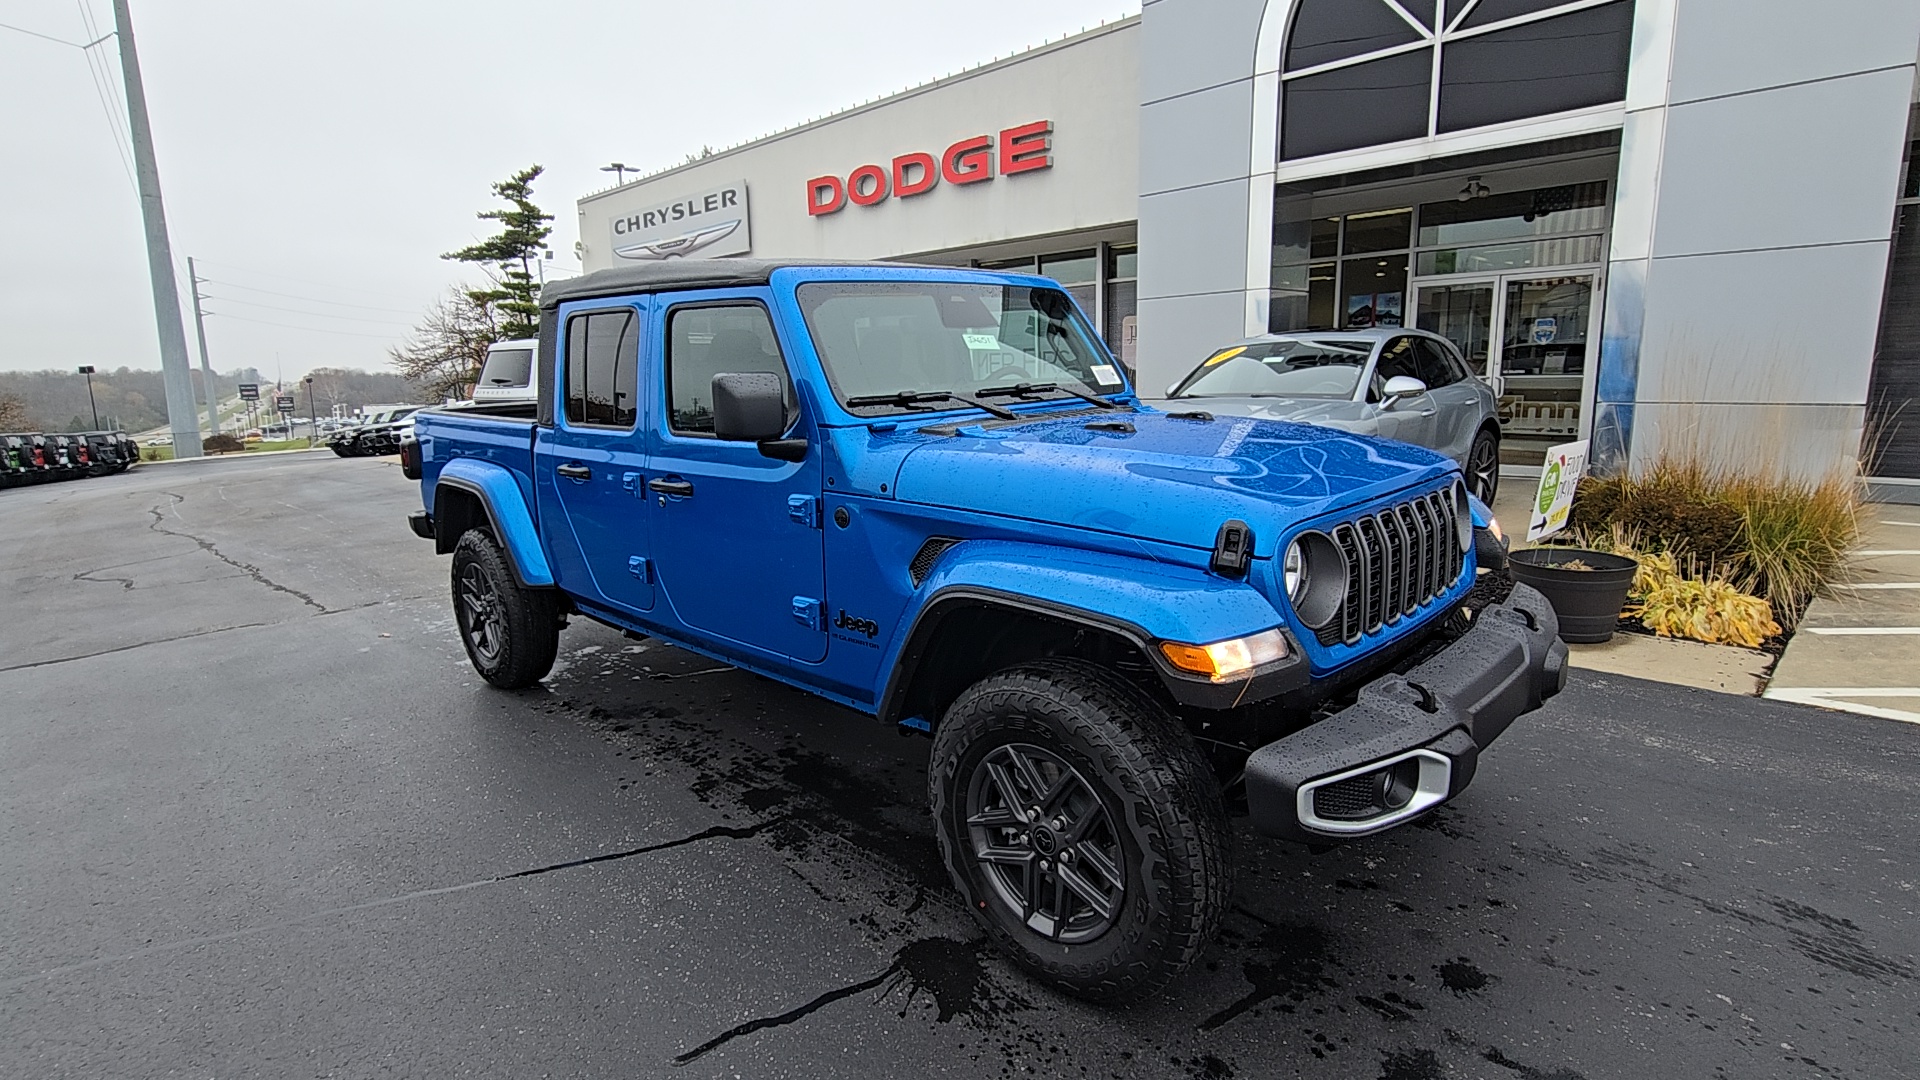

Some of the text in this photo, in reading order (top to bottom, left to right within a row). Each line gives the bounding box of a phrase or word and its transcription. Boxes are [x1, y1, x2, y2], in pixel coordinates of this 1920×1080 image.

[807, 120, 1054, 217] DODGE
[614, 188, 738, 236] CHRYSLER
[833, 608, 879, 639] Jeep
[945, 714, 1053, 780] DUELER
